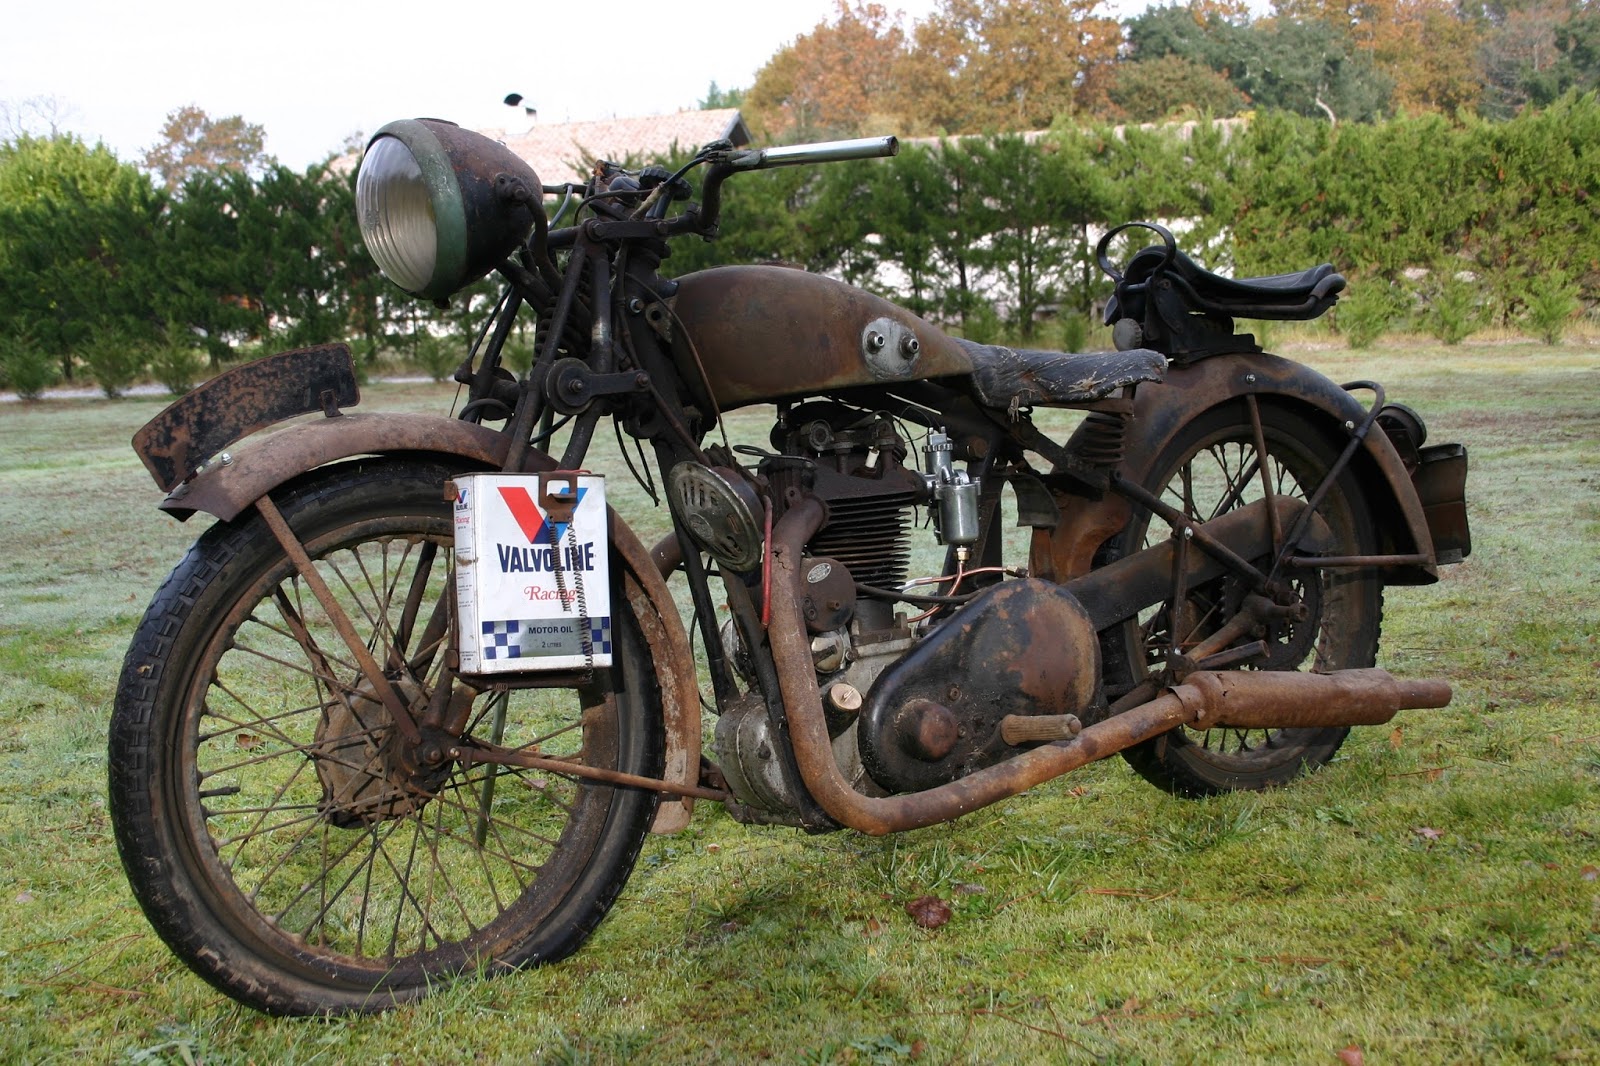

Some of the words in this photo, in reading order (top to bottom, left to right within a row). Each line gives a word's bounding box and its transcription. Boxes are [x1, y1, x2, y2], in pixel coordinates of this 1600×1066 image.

[524, 586, 577, 602] Racing
[528, 626, 559, 635] MOTOR
[560, 626, 573, 634] OIL
[541, 641, 546, 649] 2
